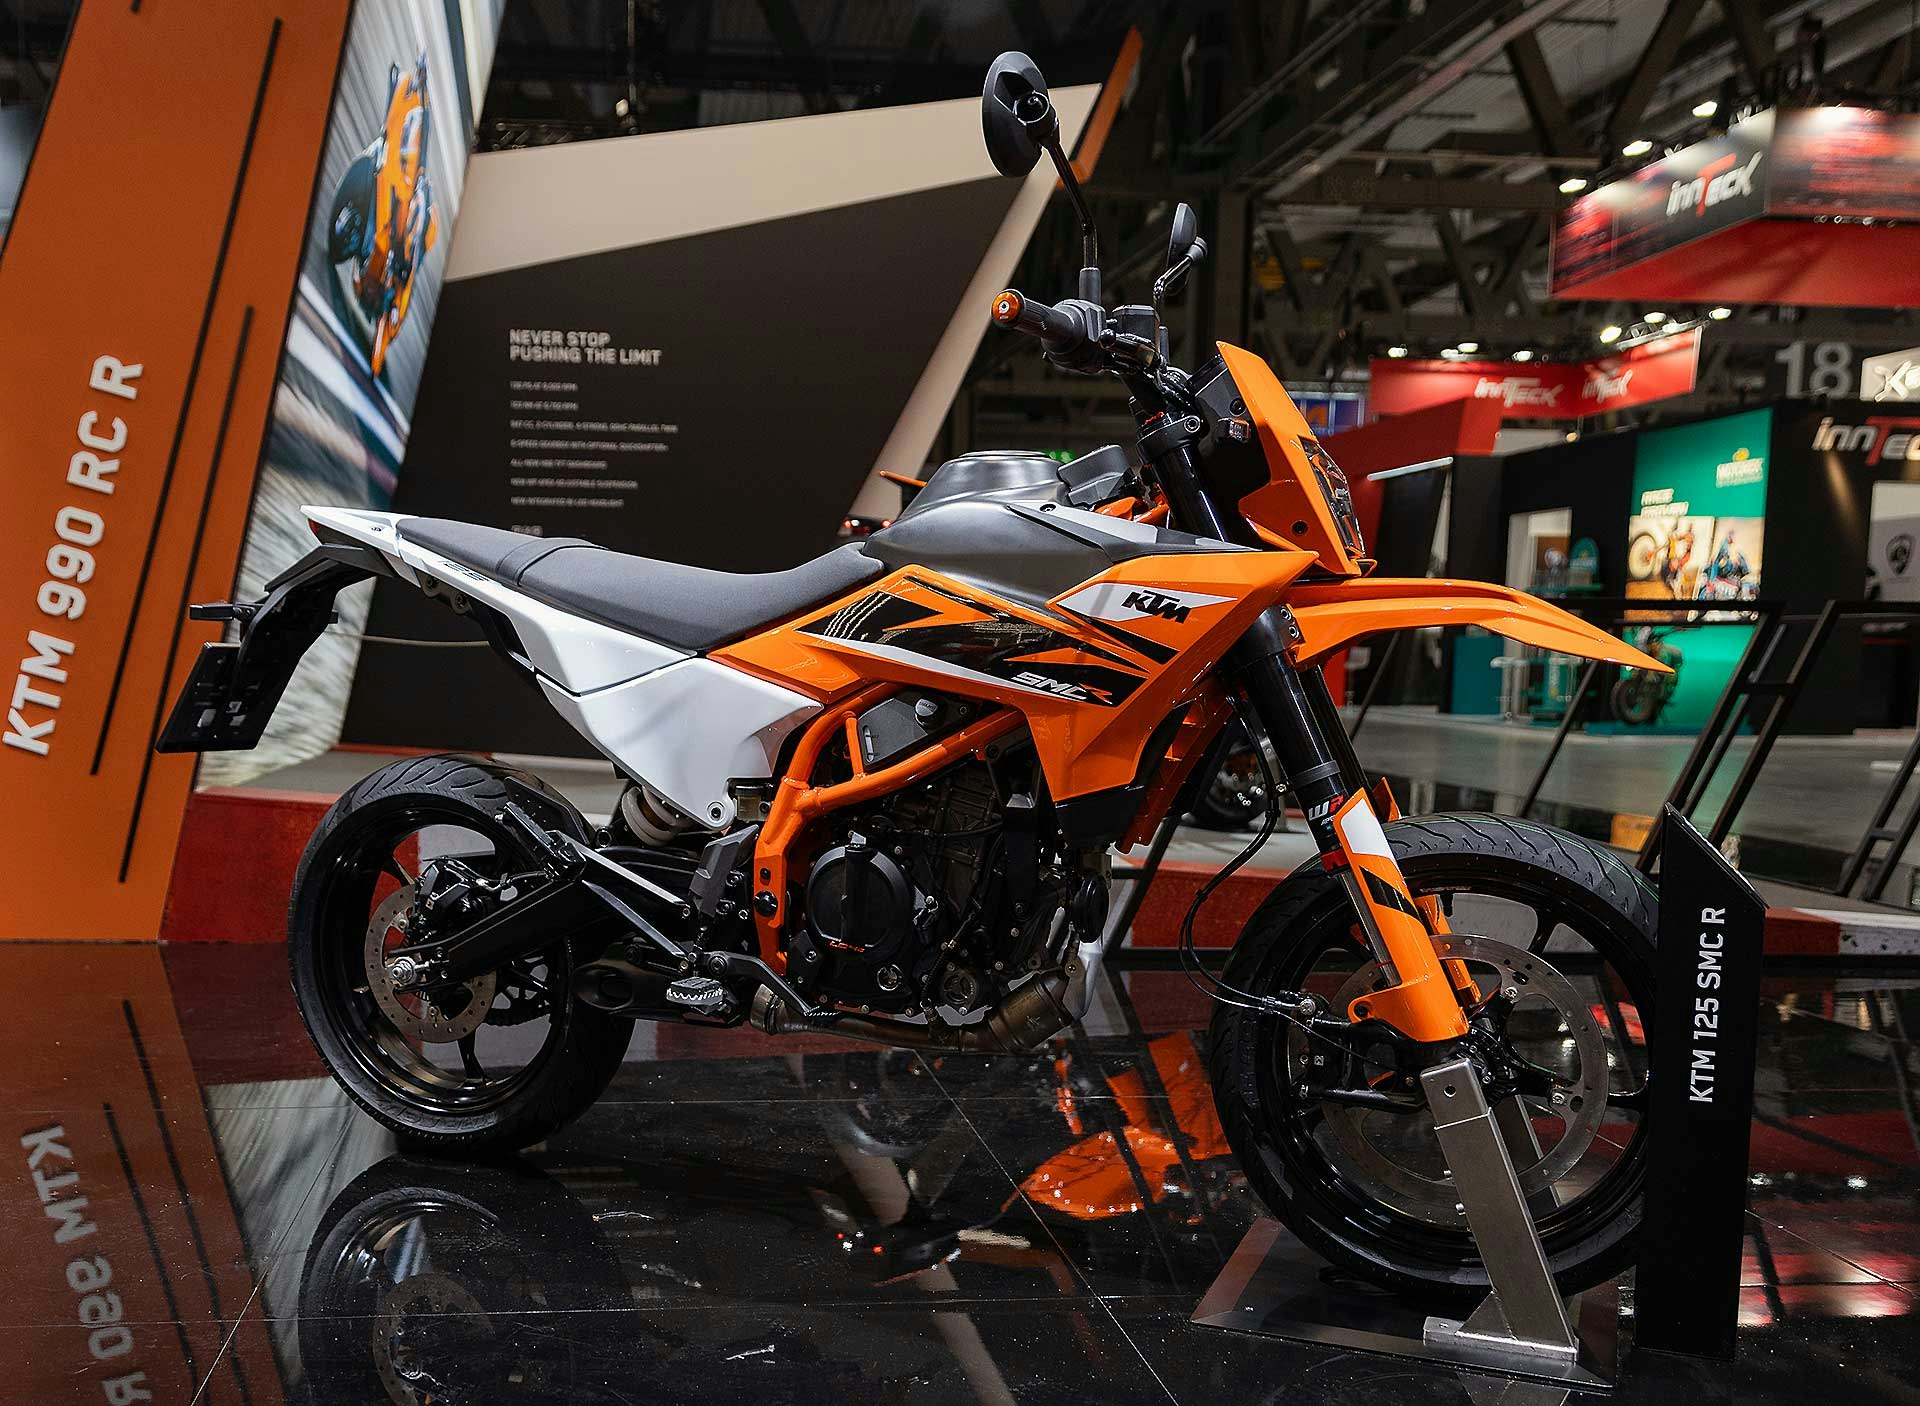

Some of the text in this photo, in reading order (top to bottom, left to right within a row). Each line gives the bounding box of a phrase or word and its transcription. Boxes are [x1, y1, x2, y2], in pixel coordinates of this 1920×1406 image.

[510, 329, 611, 347] NEVER STOP
[510, 345, 662, 366] PUSHING THE LIMIT
[1775, 340, 1853, 399] 18
[2, 355, 144, 756] KTM 990 RC R
[1121, 590, 1191, 624] KTM
[1690, 907, 1725, 1102] KTM 125 SMC R
